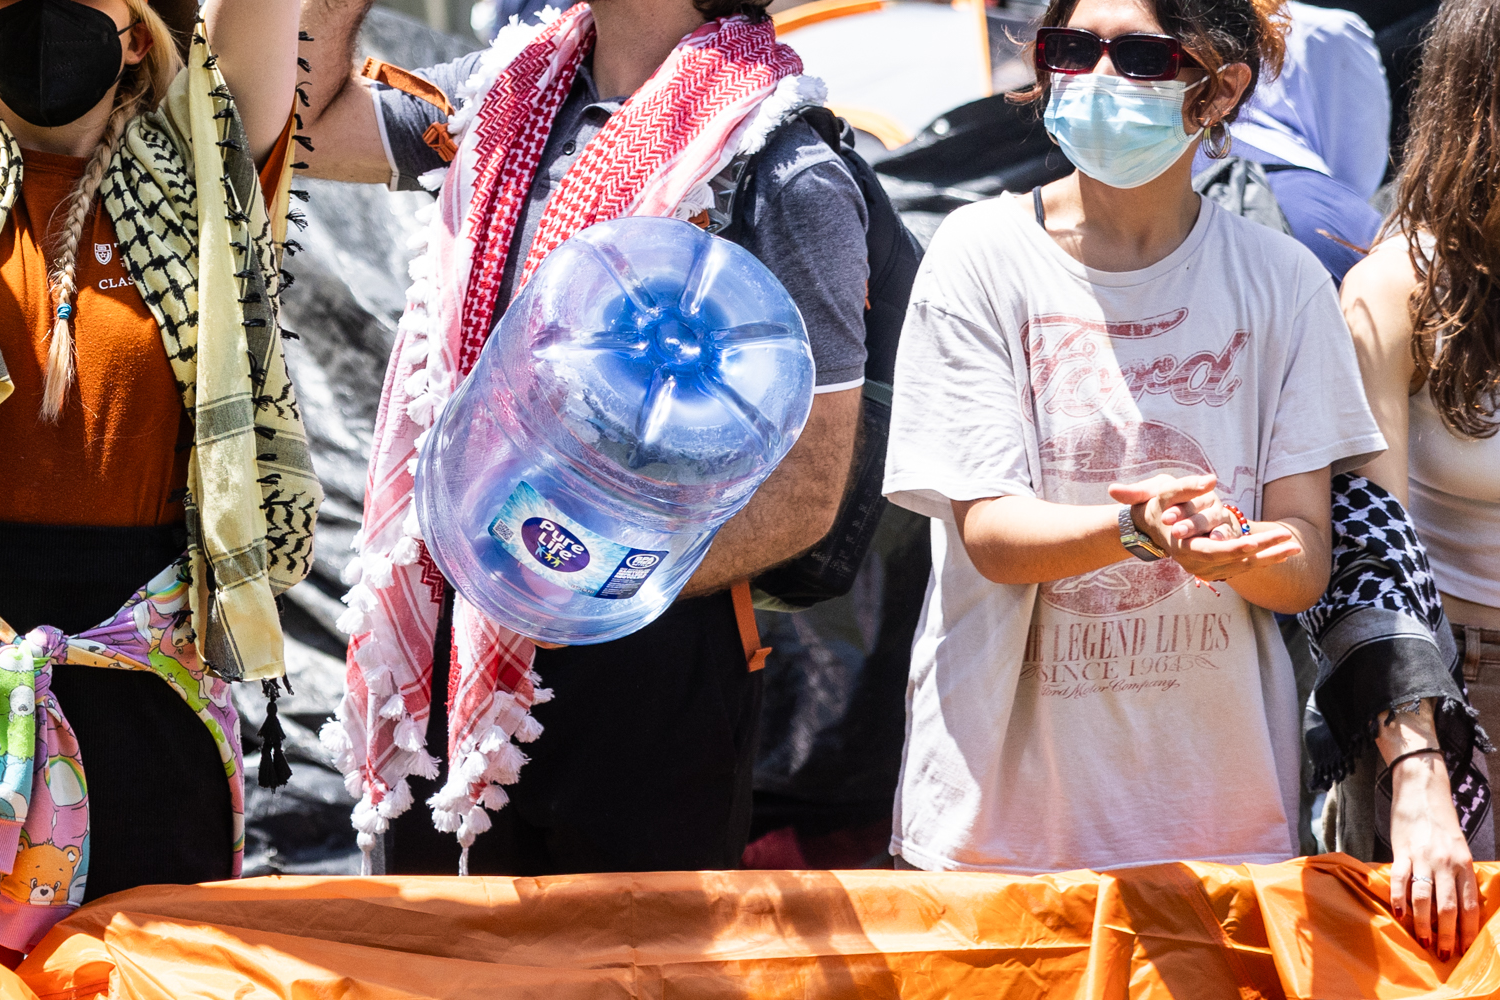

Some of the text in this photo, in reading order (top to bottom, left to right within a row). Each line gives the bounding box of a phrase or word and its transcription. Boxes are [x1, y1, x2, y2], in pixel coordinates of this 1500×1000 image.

[1018, 307, 1251, 424] Ford
[539, 520, 585, 555] Pure
[1024, 613, 1231, 663] HE LEGEND LIVES
[1038, 660, 1120, 684] SINCE
[1108, 678, 1181, 694] Company
